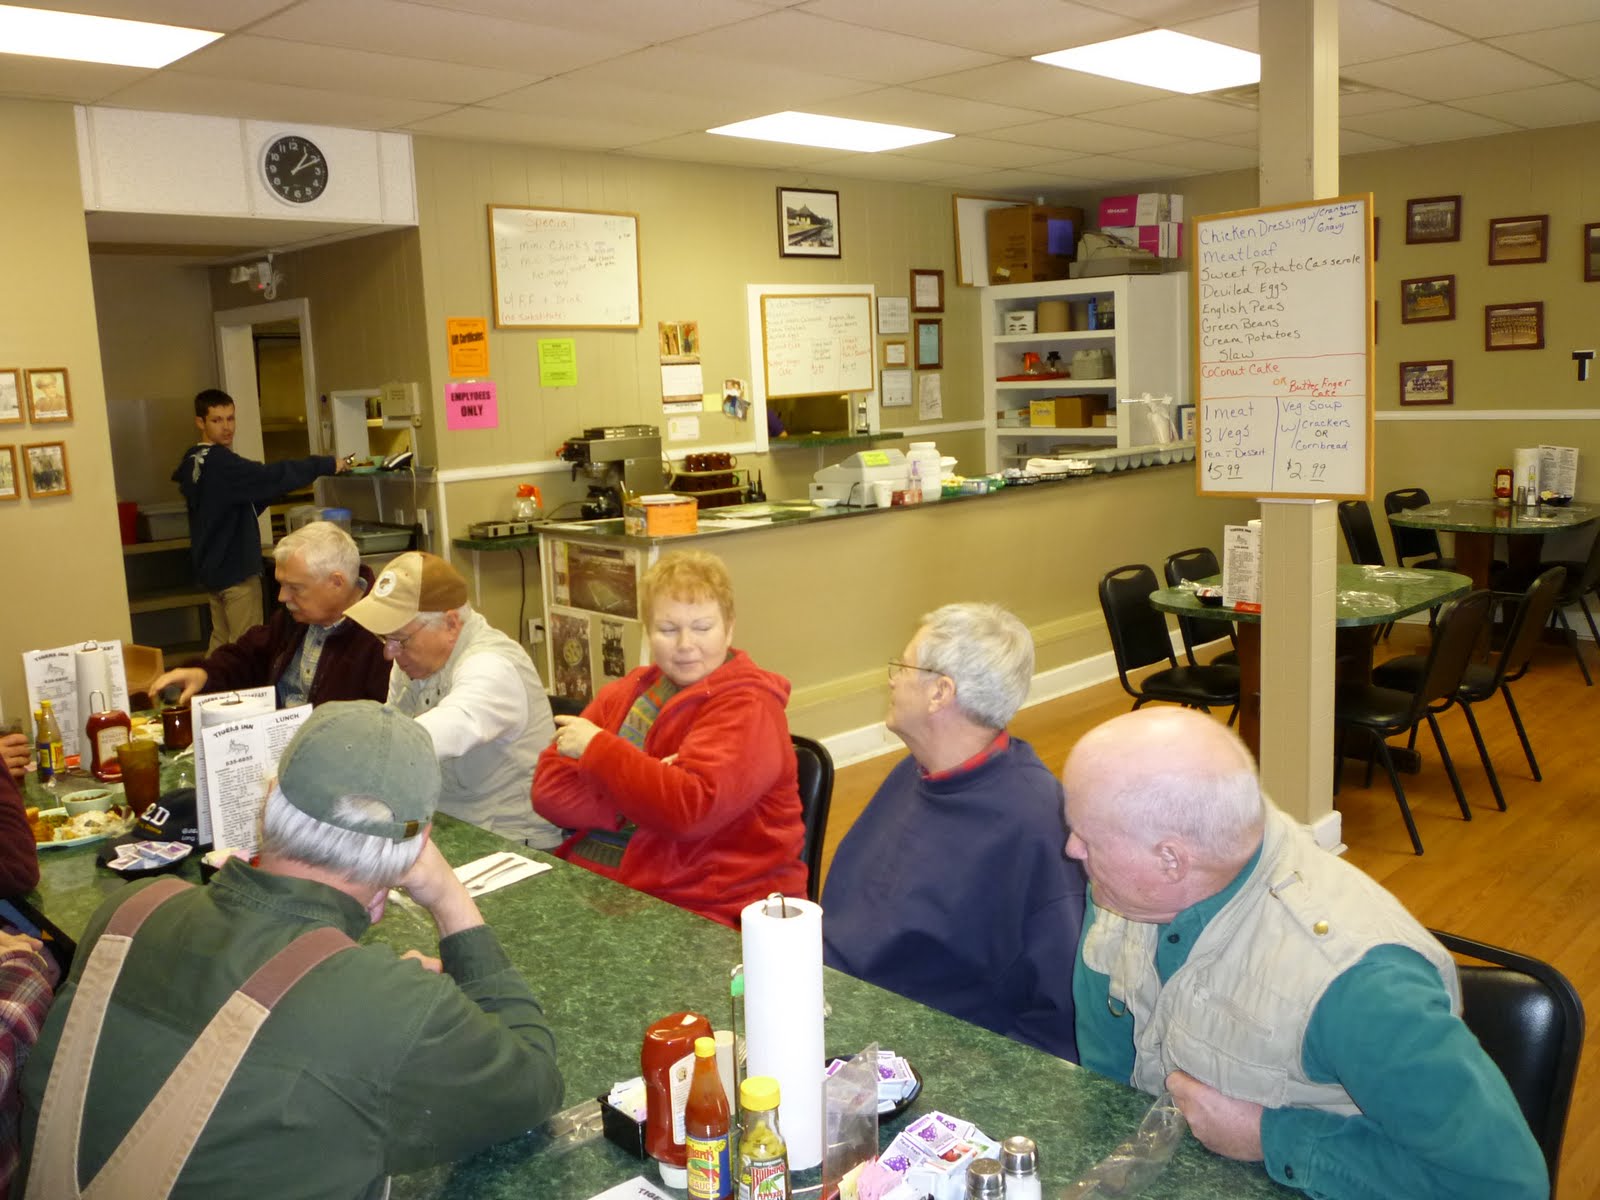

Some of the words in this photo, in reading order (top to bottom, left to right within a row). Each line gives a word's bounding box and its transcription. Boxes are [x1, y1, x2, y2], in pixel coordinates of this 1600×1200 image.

[279, 144, 286, 153] 11
[289, 142, 299, 151] 12
[271, 153, 280, 162] 10
[269, 164, 277, 173] 9
[314, 167, 321, 176] 3
[273, 177, 281, 186] 8
[312, 179, 319, 187] 4
[282, 186, 289, 194] 7
[294, 190, 302, 198] 6
[305, 187, 312, 195] 5
[1257, 218, 1307, 236] Dressing
[1316, 222, 1345, 235] Gravy
[1200, 267, 1248, 282] Sweet
[1252, 259, 1303, 276] Potato
[1304, 253, 1361, 271] Casserole
[1201, 283, 1253, 299] Deviled
[1259, 281, 1288, 299] Eggs
[1202, 303, 1248, 319] English
[1249, 299, 1285, 313] Peas
[1201, 318, 1239, 333] Green
[1240, 317, 1280, 329] Beans
[1202, 334, 1244, 347] Cream
[1247, 329, 1301, 345] Potatoes
[1219, 348, 1254, 363] Slaw
[1572, 350, 1597, 381] T
[1289, 379, 1319, 393] Butter
[460, 405, 484, 418] ONLY
[1282, 401, 1302, 416] Veg
[1308, 400, 1343, 412] Soup
[1204, 427, 1212, 443] 3
[1218, 423, 1250, 446] Vegs
[1295, 440, 1349, 450] Cornbread
[1234, 448, 1266, 459] Dessert
[274, 713, 300, 724] LUNCH
